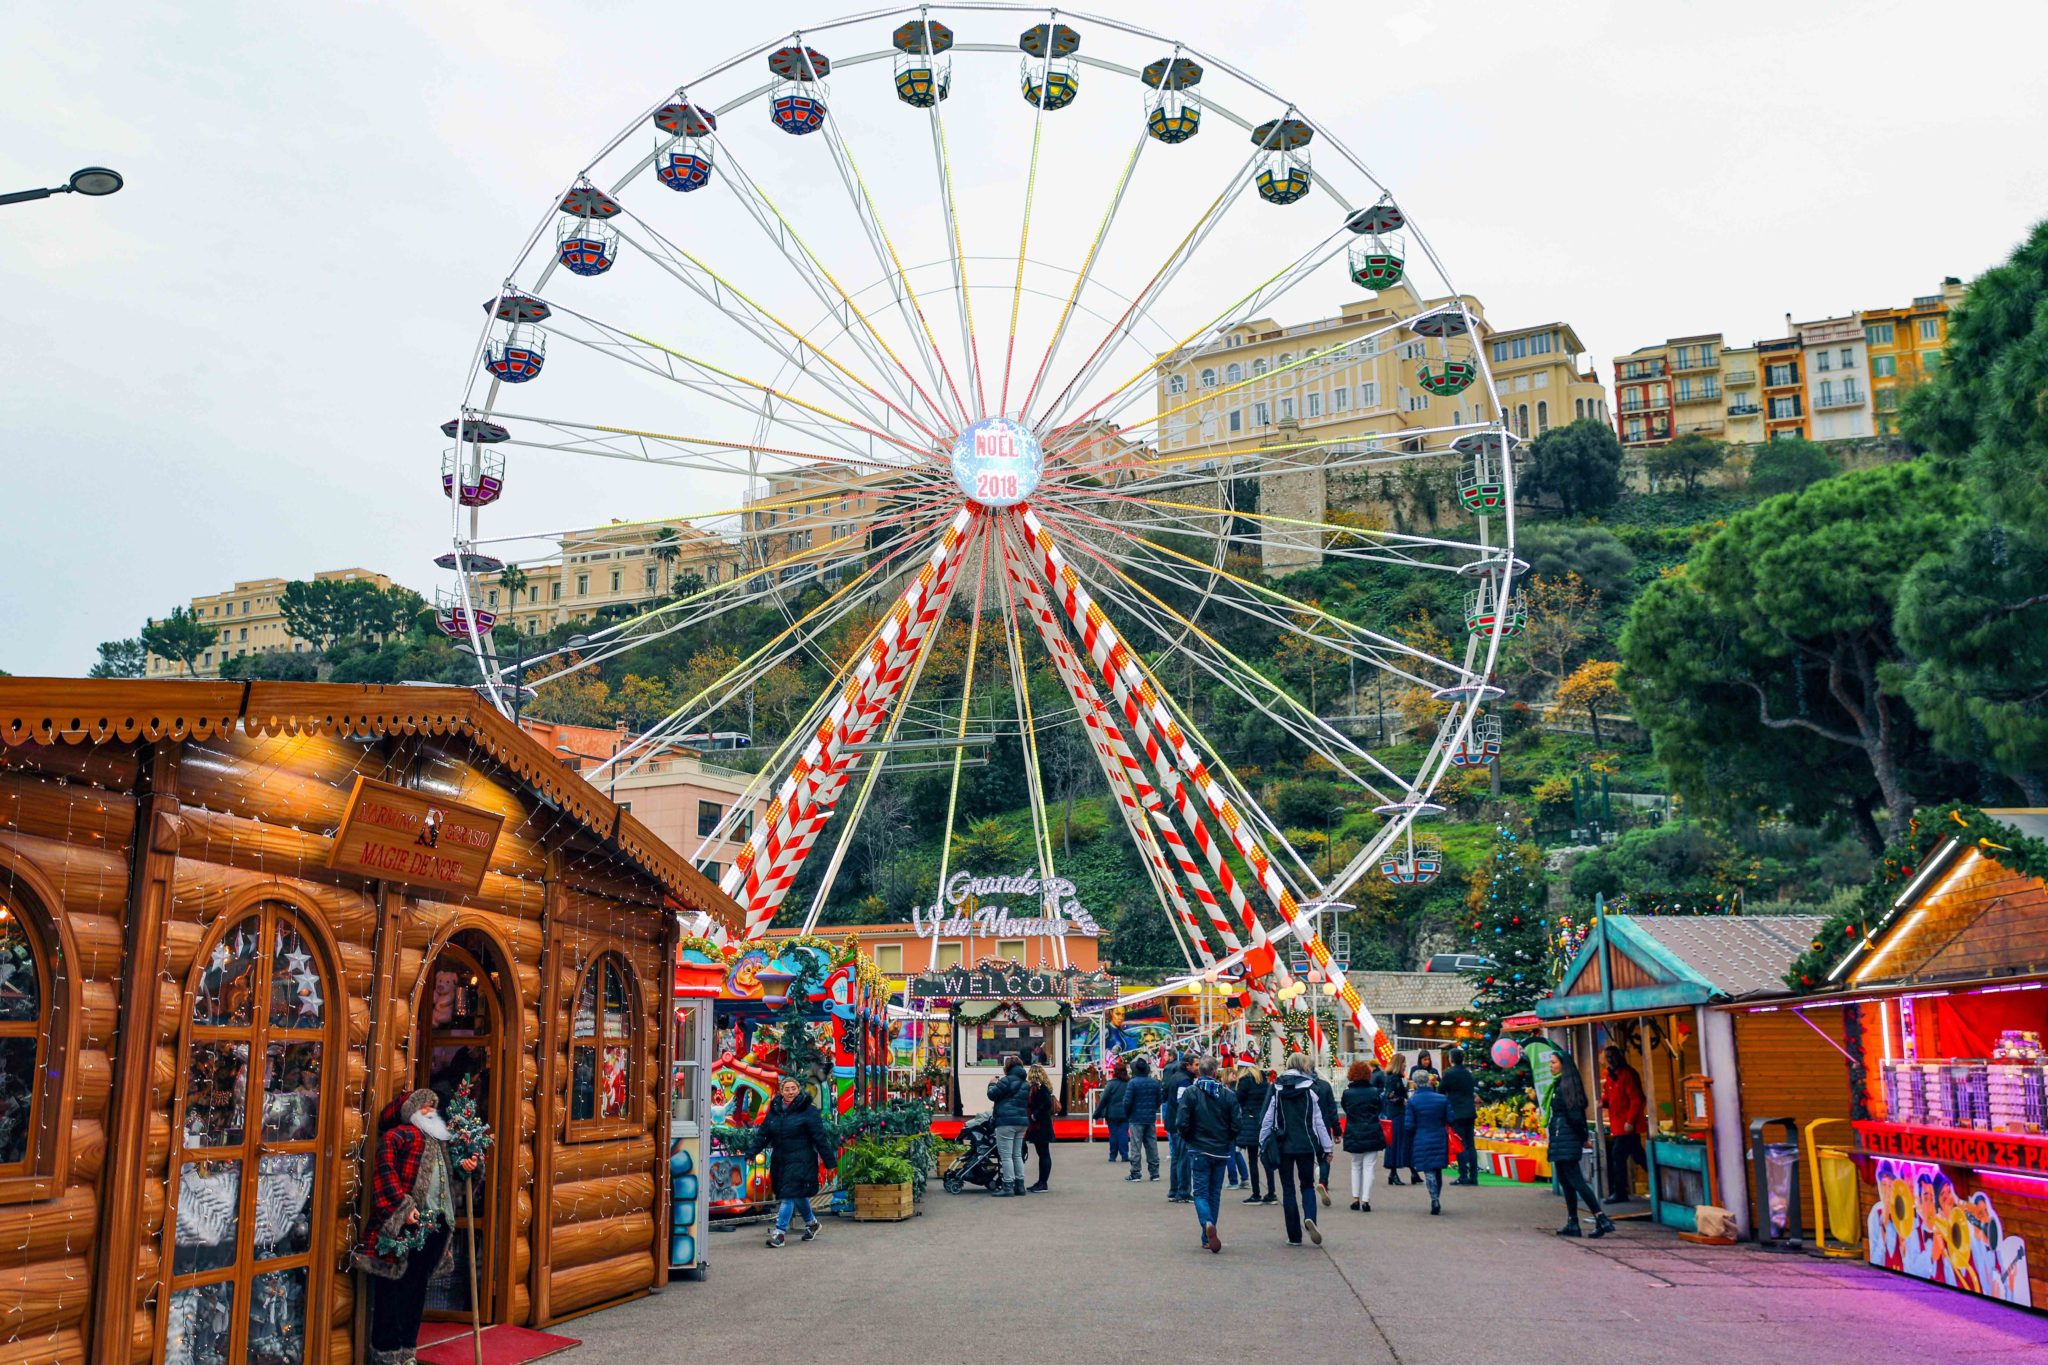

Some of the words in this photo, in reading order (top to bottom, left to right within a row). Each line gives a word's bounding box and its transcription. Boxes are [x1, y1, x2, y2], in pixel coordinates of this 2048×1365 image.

[977, 475, 1017, 498] 2018
[359, 841, 409, 871] MAGIE
[409, 853, 432, 876] DE
[946, 868, 1040, 905] Grande
[944, 906, 971, 937] de
[973, 905, 1069, 938] Monaco
[943, 976, 1086, 995] WELCOME
[1861, 1130, 1898, 1155] TETE
[1901, 1133, 1922, 1157] DE
[1926, 1135, 1989, 1165] CHOCO
[1994, 1142, 2019, 1169] 25
